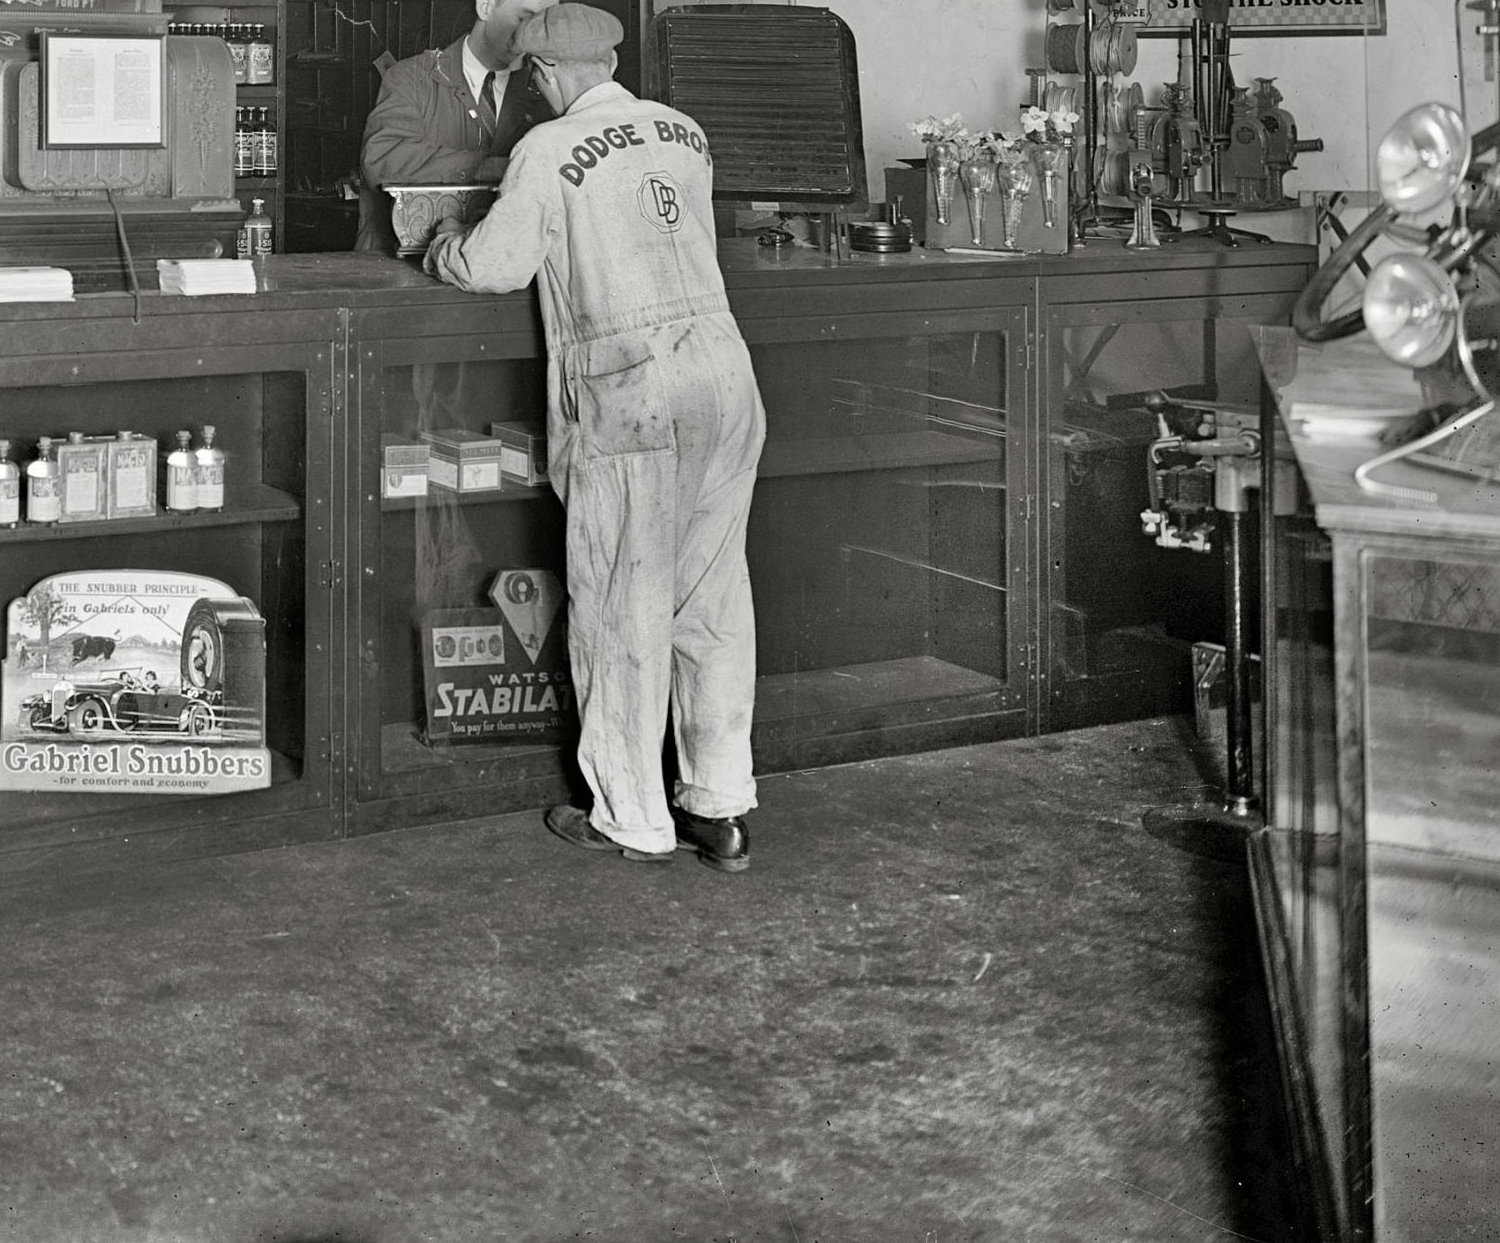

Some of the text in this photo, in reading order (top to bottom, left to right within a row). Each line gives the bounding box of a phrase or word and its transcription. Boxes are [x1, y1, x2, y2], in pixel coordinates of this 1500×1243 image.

[558, 123, 645, 188] DODGE
[59, 583, 79, 592] THE
[86, 583, 137, 593] SNUBBER
[63, 603, 76, 613] in
[83, 603, 136, 614] Gabriels
[488, 672, 566, 686] WATSO
[451, 721, 465, 733] You
[467, 722, 482, 736] pay
[484, 720, 495, 732] for
[497, 720, 516, 731] them
[3, 743, 264, 776] Gabriel Snubbers
[81, 776, 129, 786] comfort
[132, 776, 154, 787] and
[157, 779, 209, 789] economy
